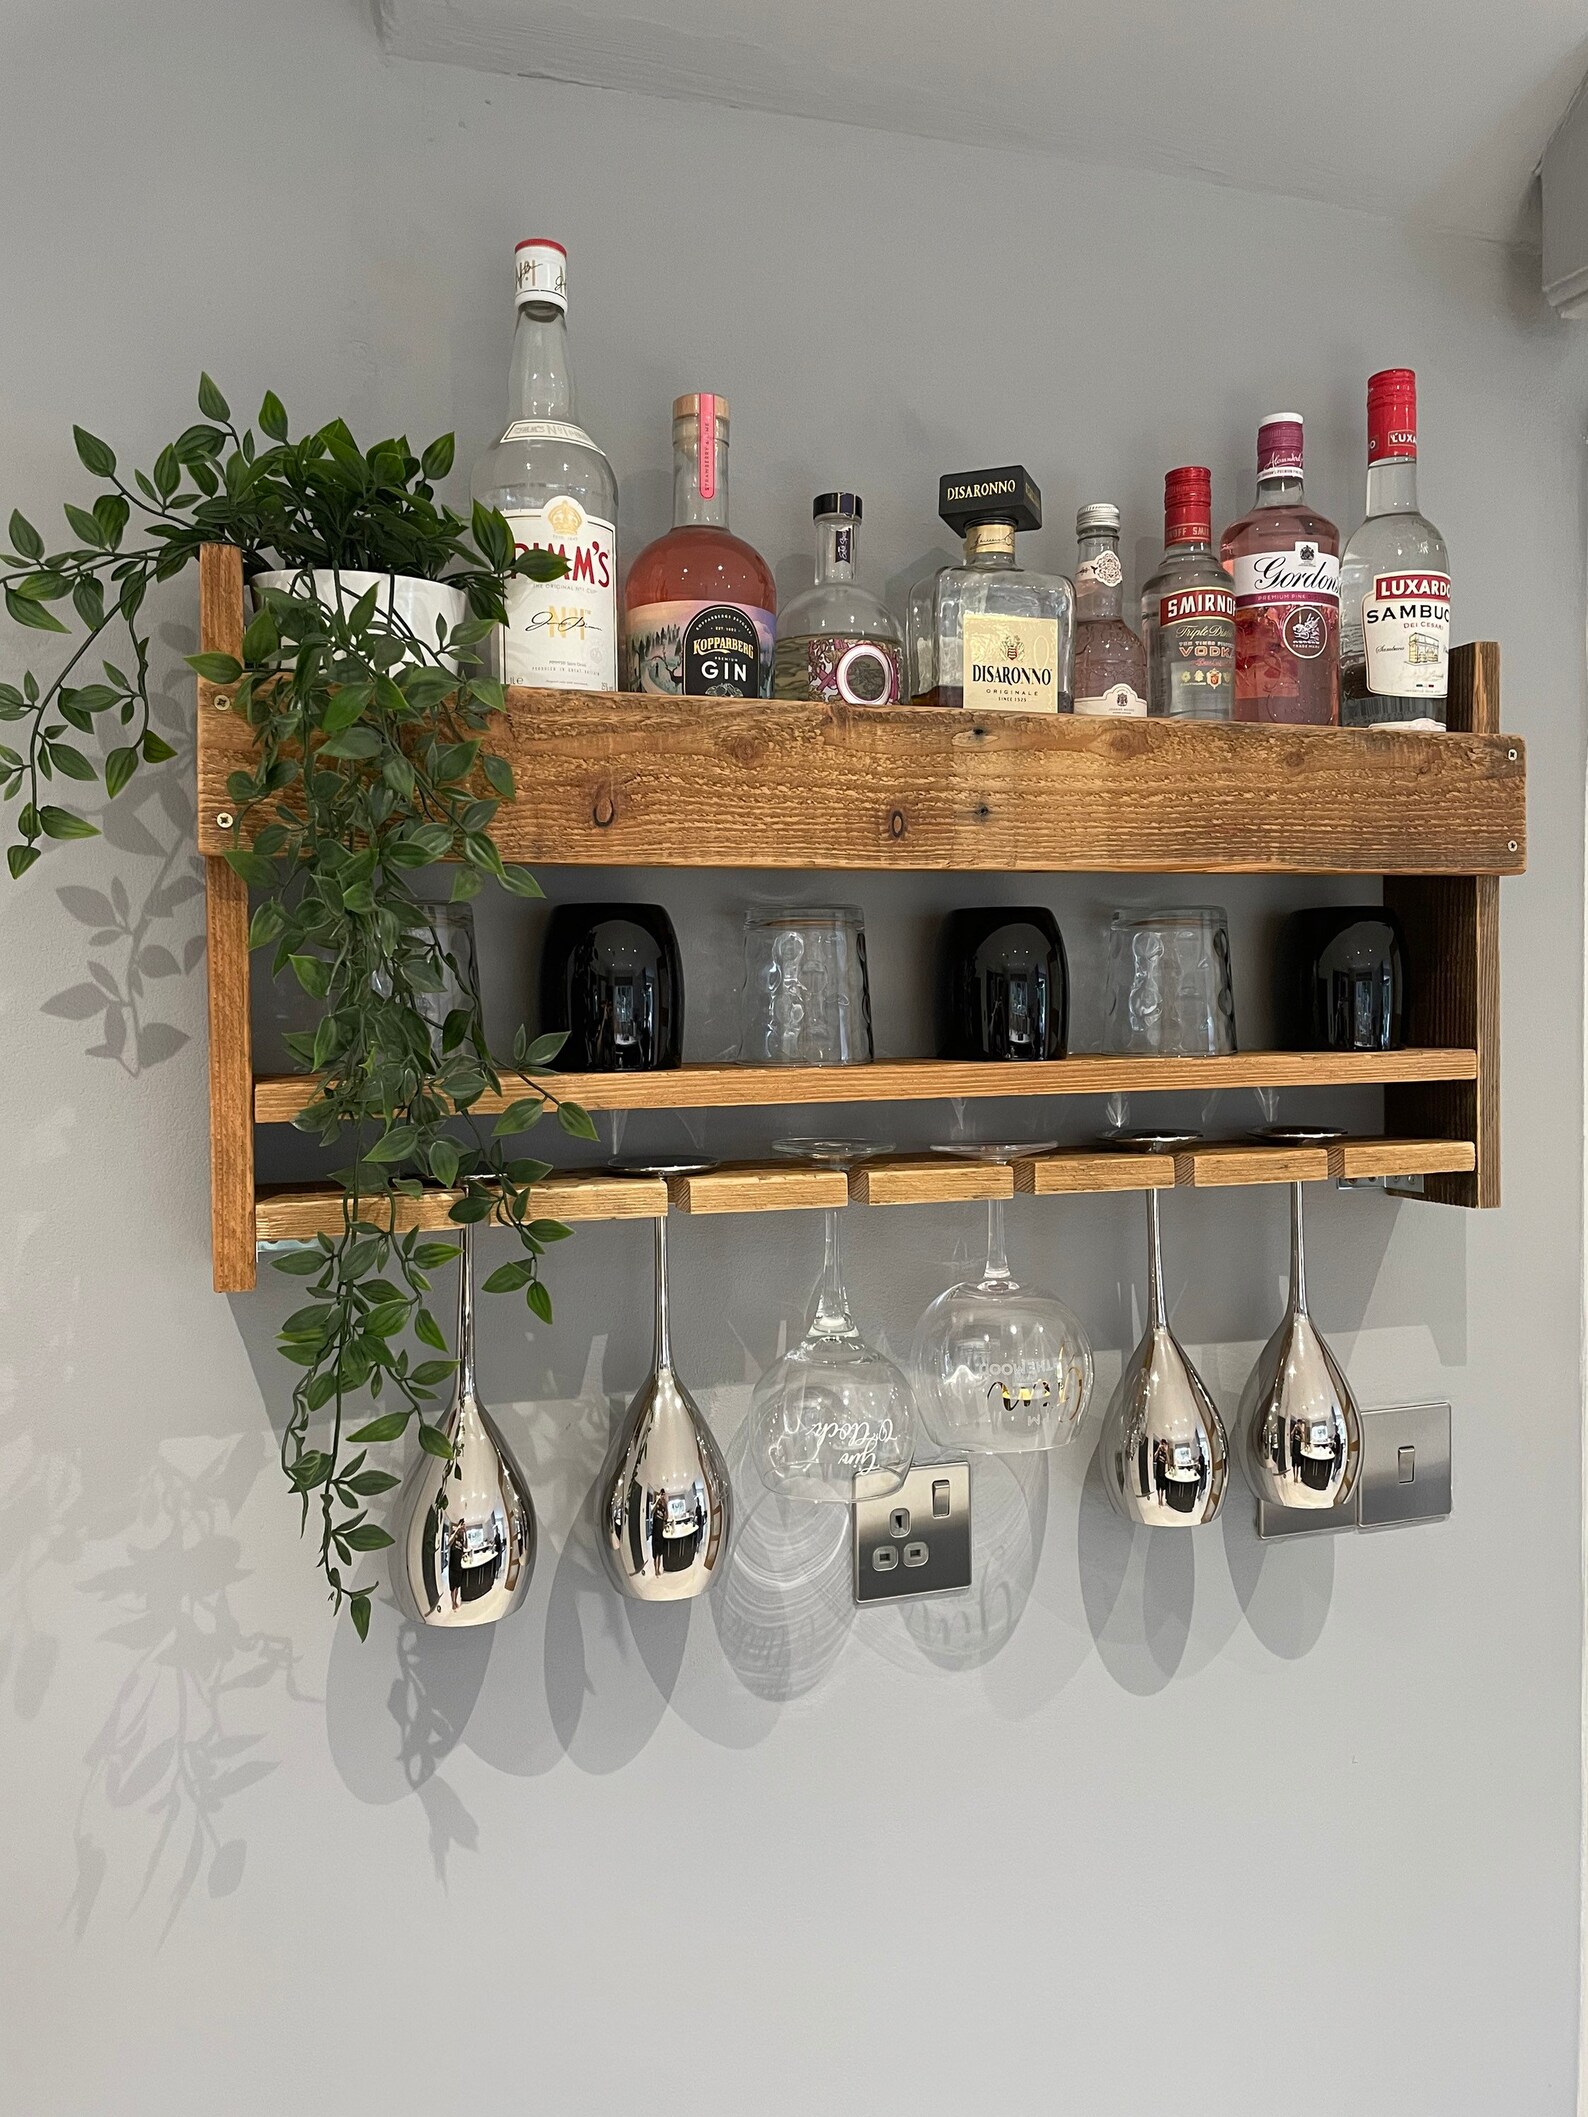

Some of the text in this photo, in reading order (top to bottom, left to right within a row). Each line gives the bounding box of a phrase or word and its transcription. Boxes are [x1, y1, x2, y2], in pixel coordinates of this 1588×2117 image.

[947, 479, 1016, 501] DISARONNO
[693, 637, 754, 659] KOPPARBERG
[701, 661, 747, 682] GIN
[972, 664, 1052, 686] DISARONNO
[986, 688, 1039, 696] ORIGINALE
